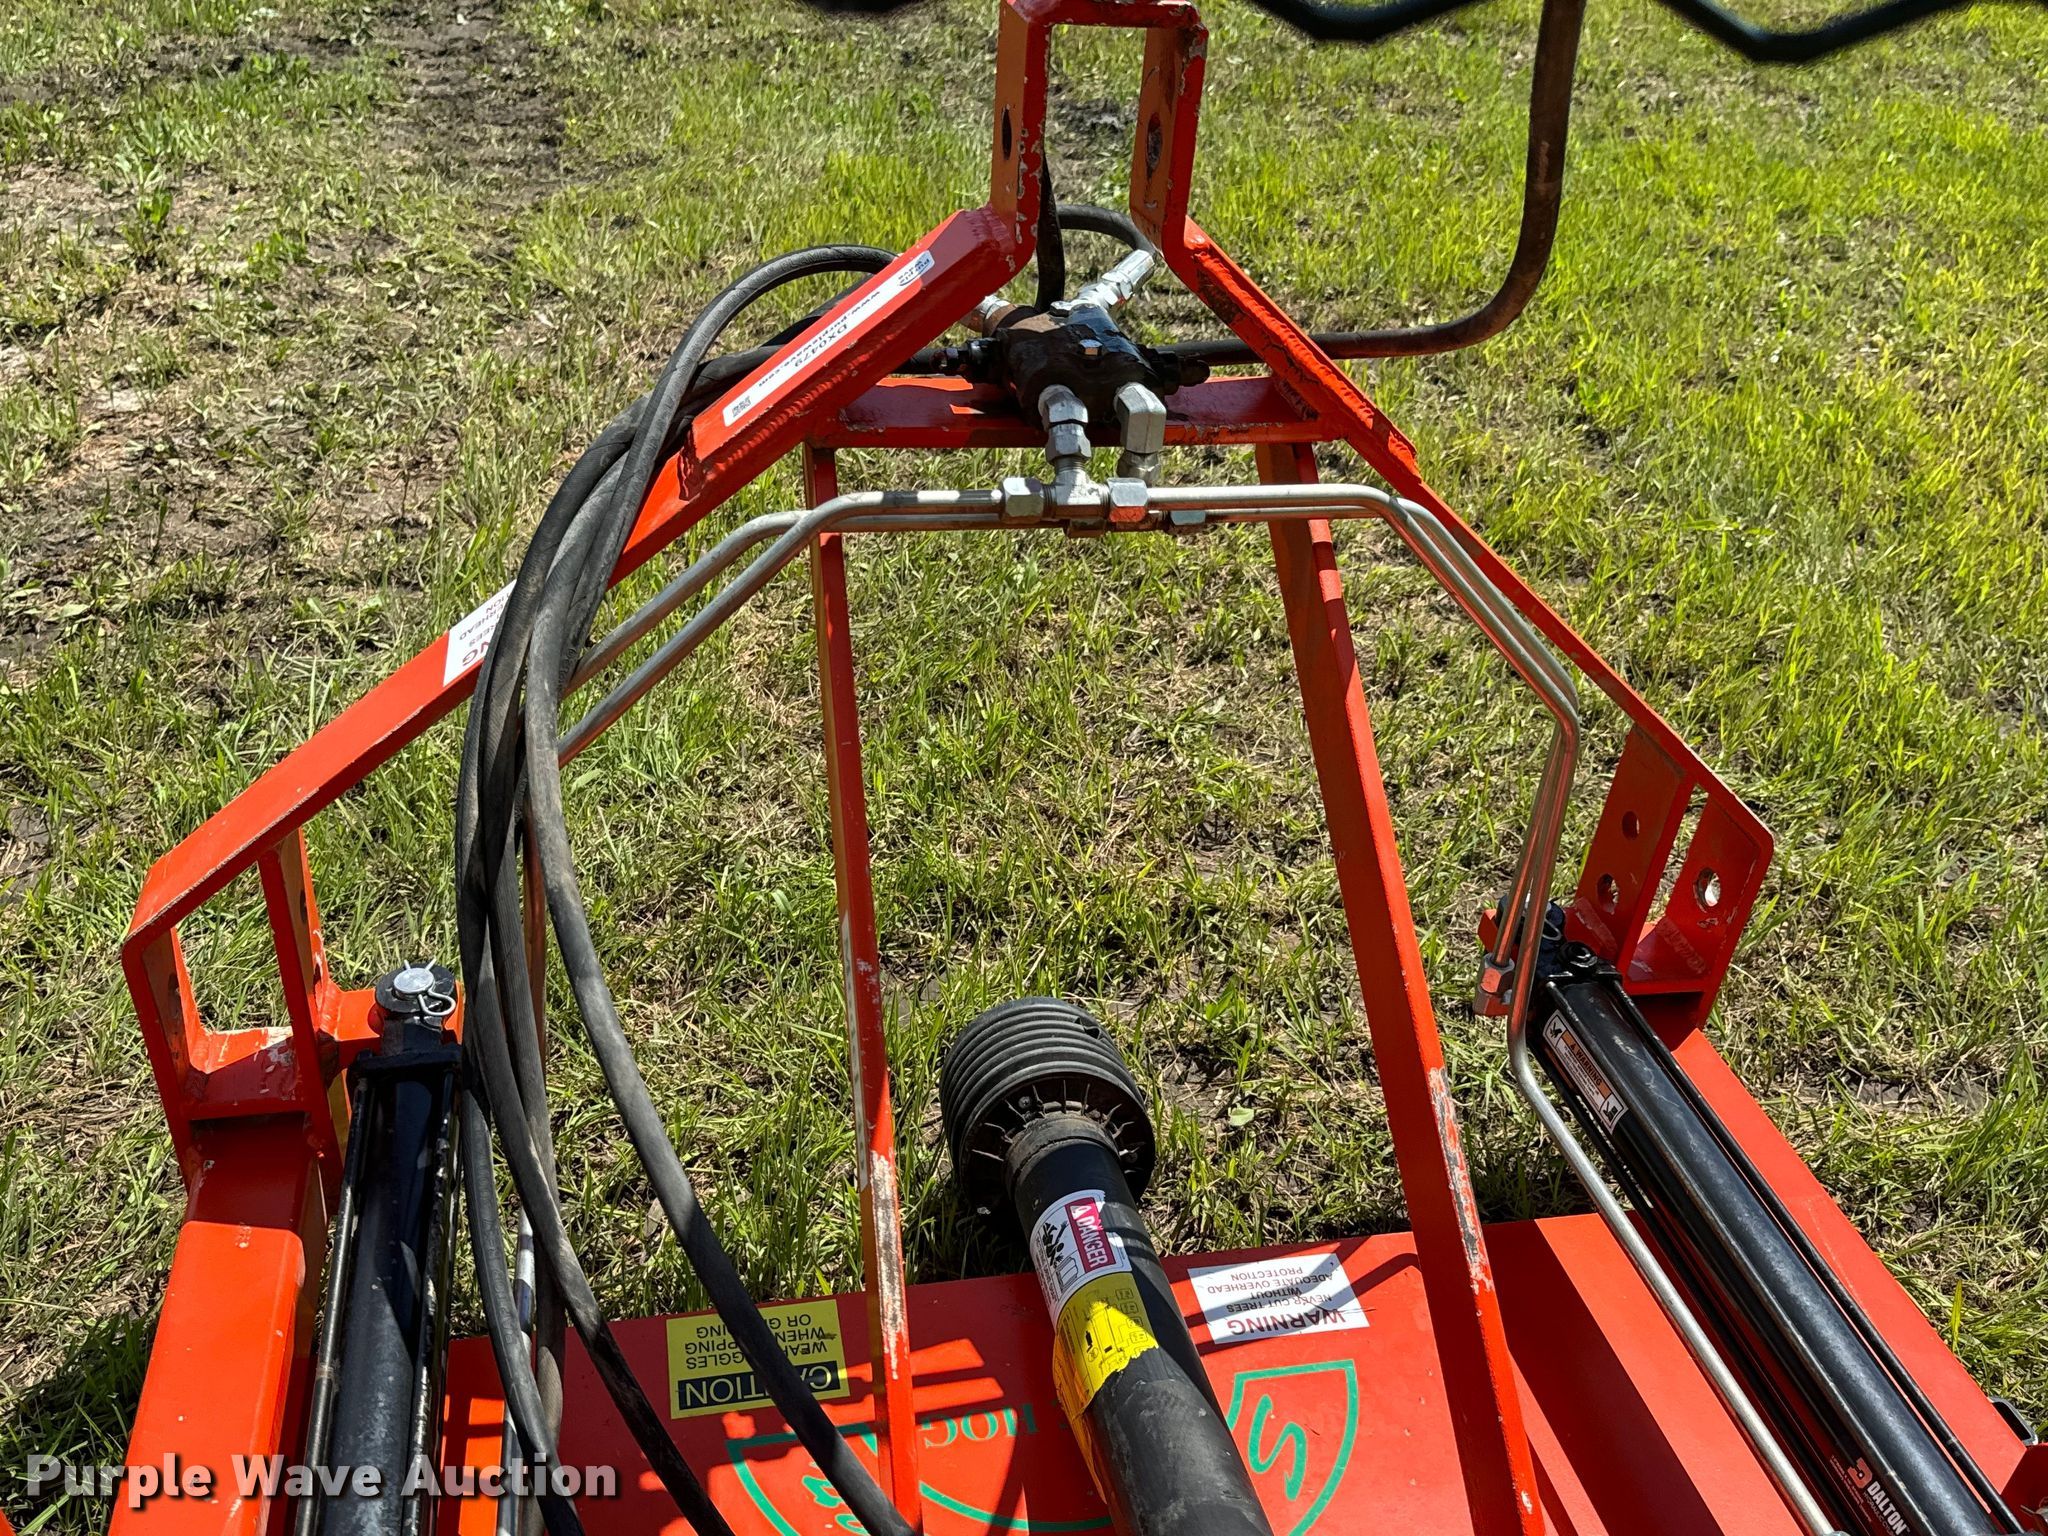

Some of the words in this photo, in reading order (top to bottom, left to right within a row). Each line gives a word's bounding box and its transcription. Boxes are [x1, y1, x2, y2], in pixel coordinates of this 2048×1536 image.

[758, 290, 881, 387] www.purplewave.com
[794, 323, 848, 368] DX0479
[459, 604, 504, 640] ERHEAD
[1575, 1051, 1602, 1086] WARNING
[1075, 1218, 1108, 1268] DANGER
[1231, 1267, 1303, 1281] PROTECTION
[1273, 1273, 1332, 1287] ADEQUATE
[1207, 1281, 1270, 1294] OVERHEAD
[1250, 1287, 1302, 1299] WITHOUT
[1226, 1302, 1263, 1313] TREES
[1268, 1299, 1289, 1308] CUT
[1292, 1294, 1332, 1306] NEVER
[787, 1314, 811, 1327] OR
[1227, 1308, 1346, 1336] WARNING
[685, 1366, 831, 1407] CTION
[1866, 1480, 1907, 1535] DALTON
